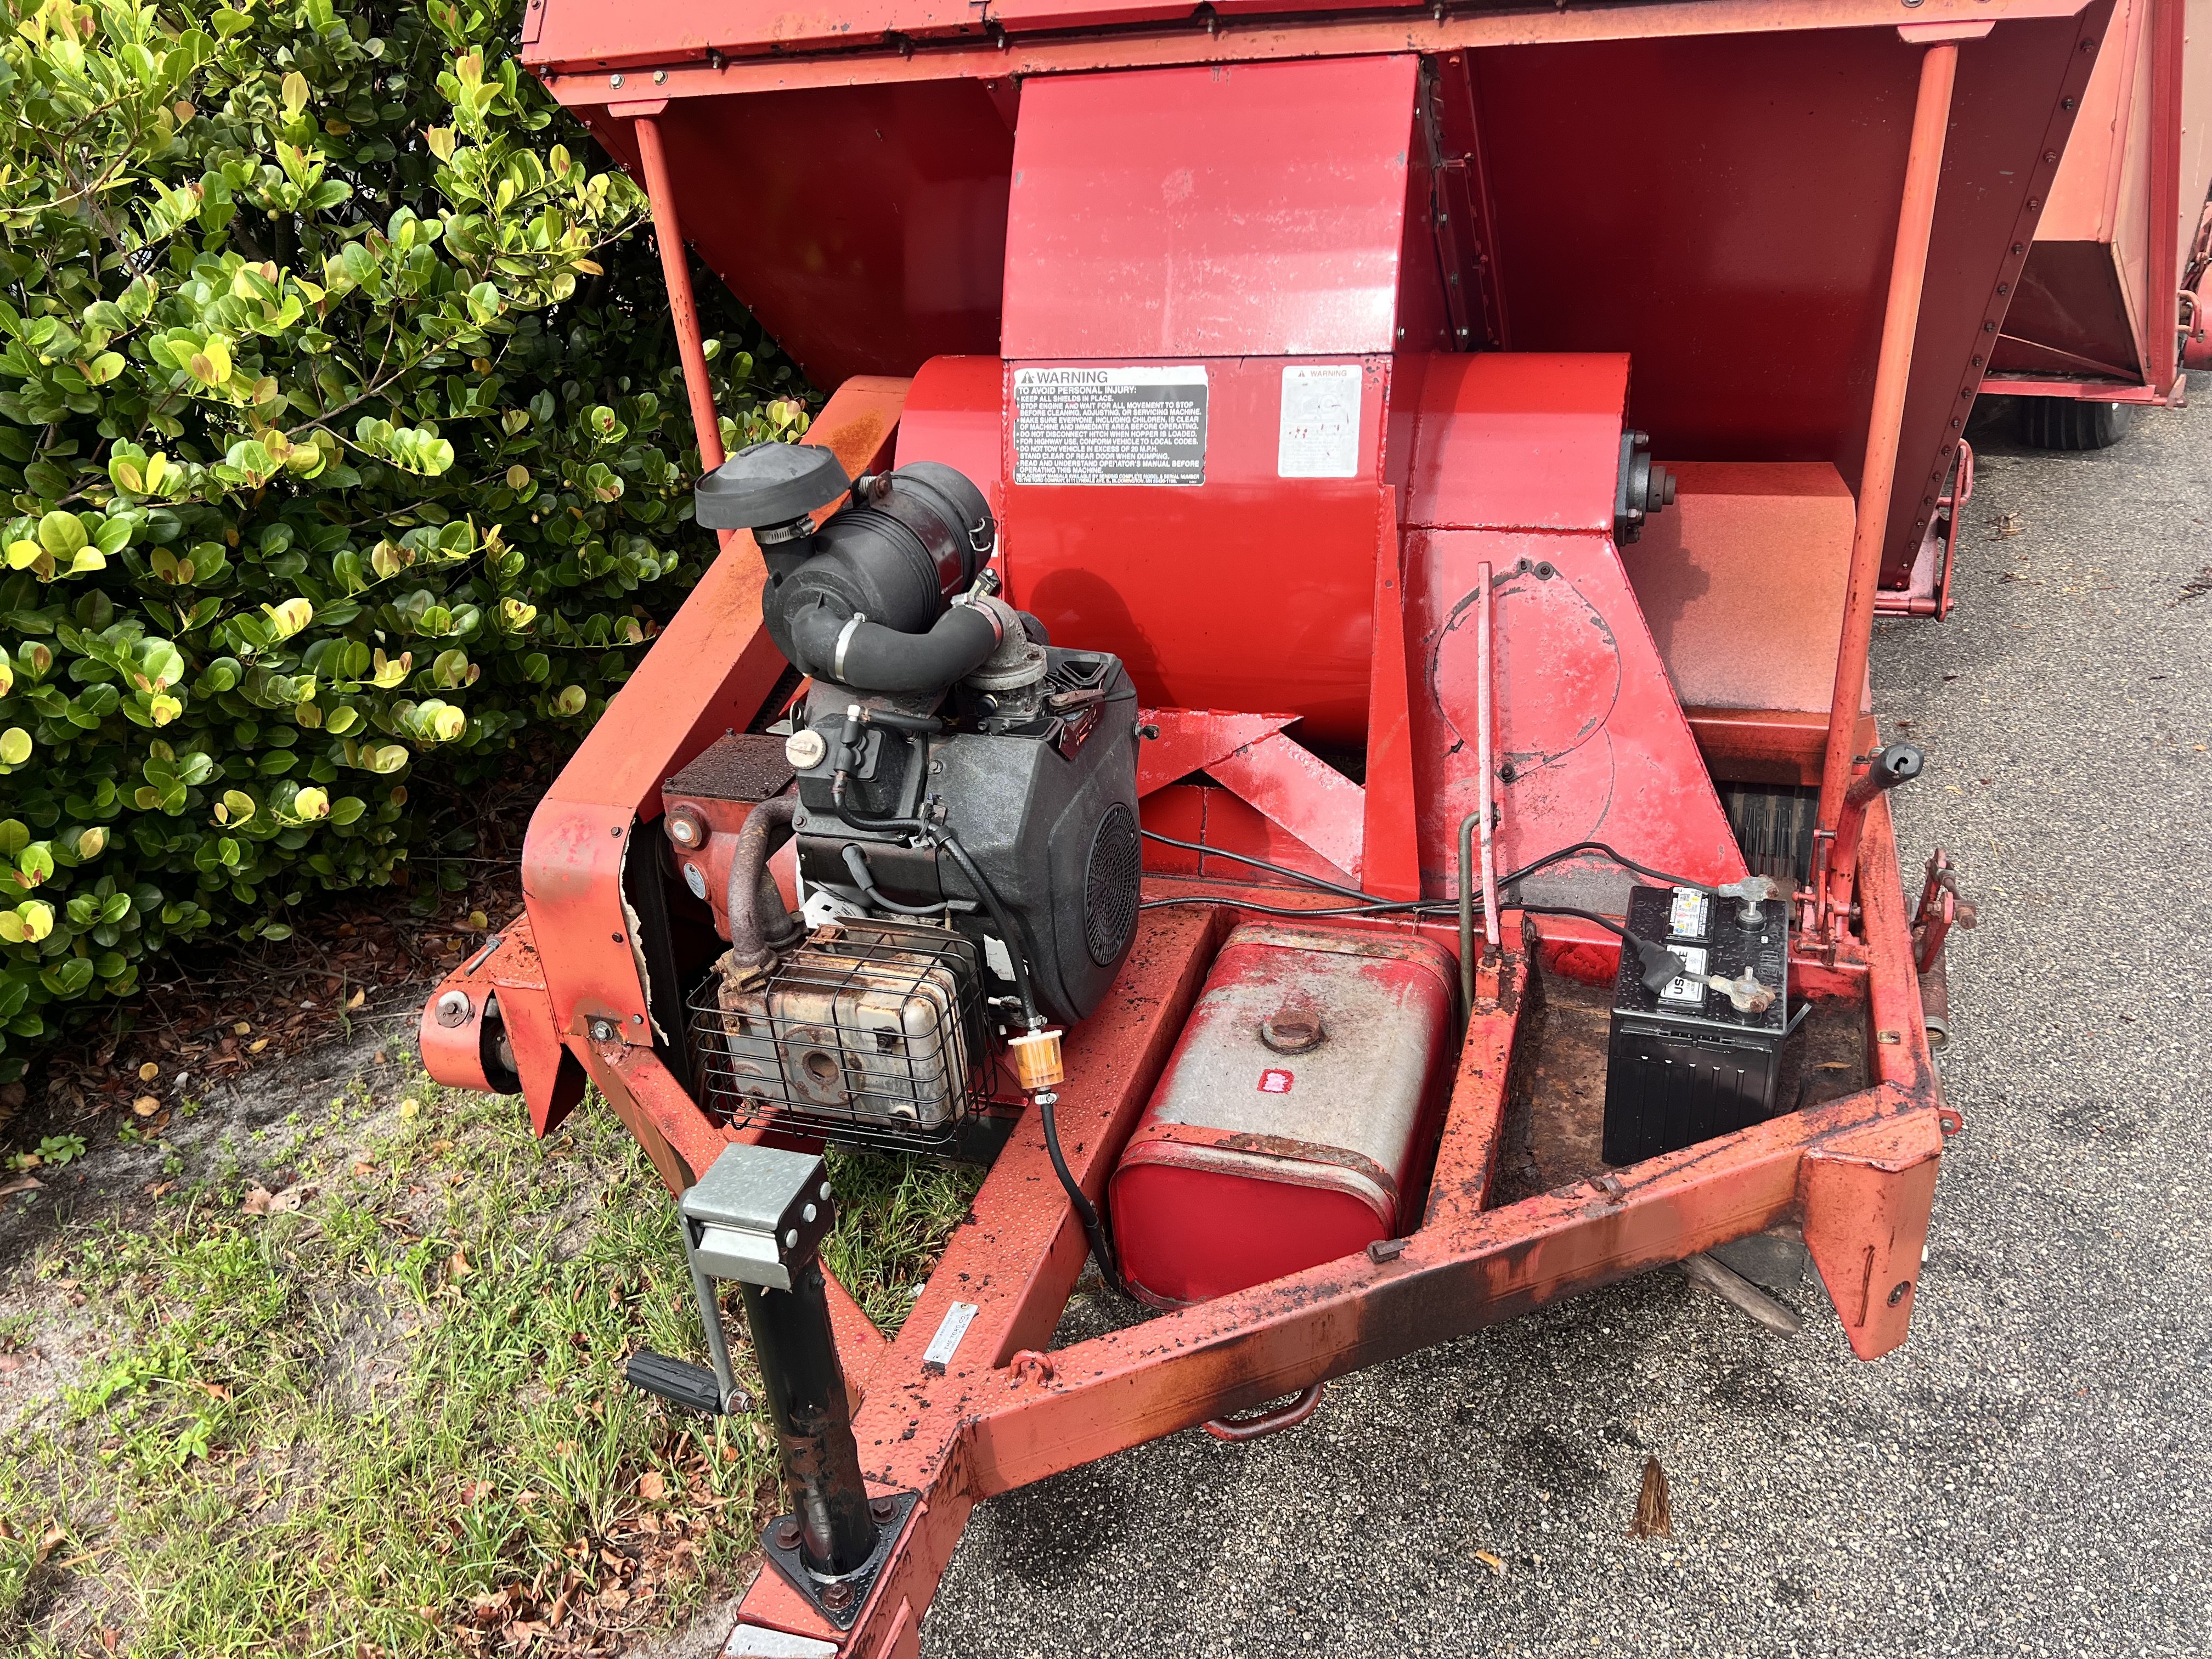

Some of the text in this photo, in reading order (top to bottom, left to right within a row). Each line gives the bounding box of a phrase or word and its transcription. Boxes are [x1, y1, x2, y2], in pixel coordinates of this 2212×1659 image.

[1036, 371, 1108, 383] WARNING
[944, 1340, 953, 1350] THE
[950, 1324, 961, 1339] TORO
